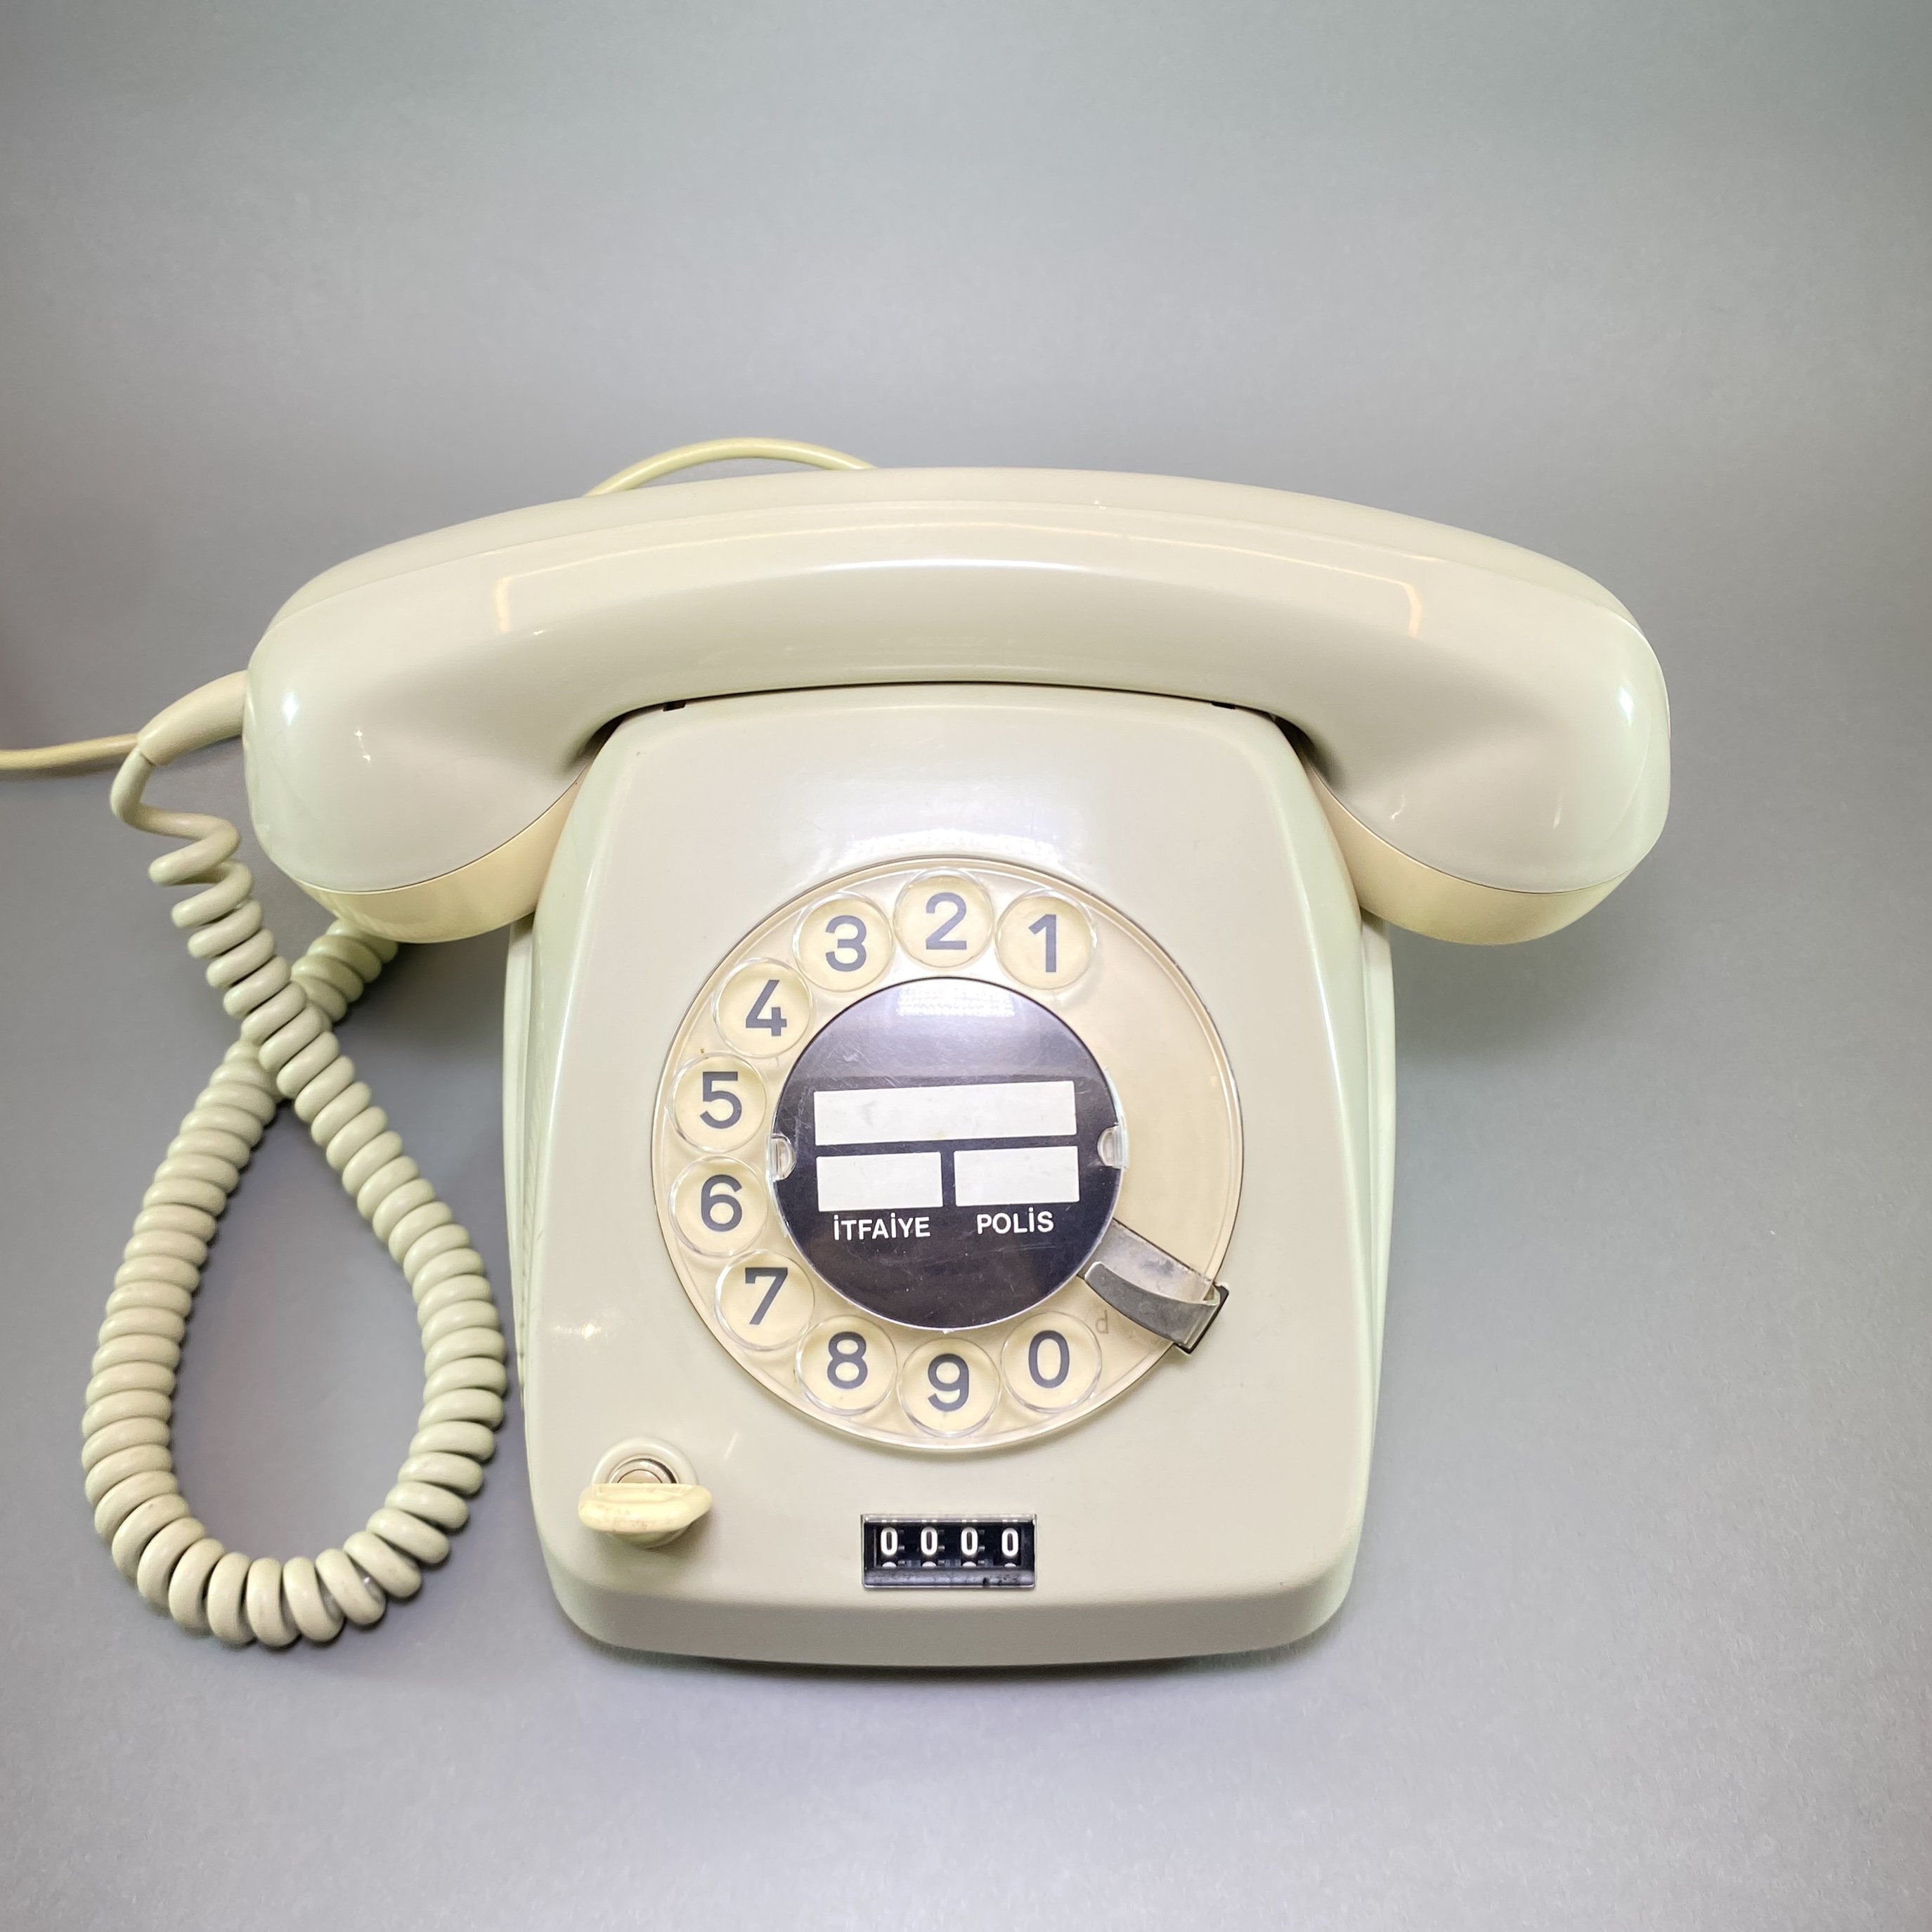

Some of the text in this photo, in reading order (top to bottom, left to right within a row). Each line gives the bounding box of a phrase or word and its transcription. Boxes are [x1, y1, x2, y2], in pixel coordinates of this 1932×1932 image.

[826, 915, 867, 972] 3
[926, 892, 967, 950] 2
[1028, 914, 1056, 973] 1
[746, 980, 787, 1036] 4
[700, 1071, 741, 1129] 5
[701, 1174, 742, 1231] 6
[834, 1212, 931, 1240] İTFAİYE
[976, 1207, 1054, 1235] POLİS
[745, 1266, 788, 1325] 7
[827, 1331, 867, 1389] 8
[928, 1352, 969, 1411] 9
[1028, 1330, 1070, 1388] 0
